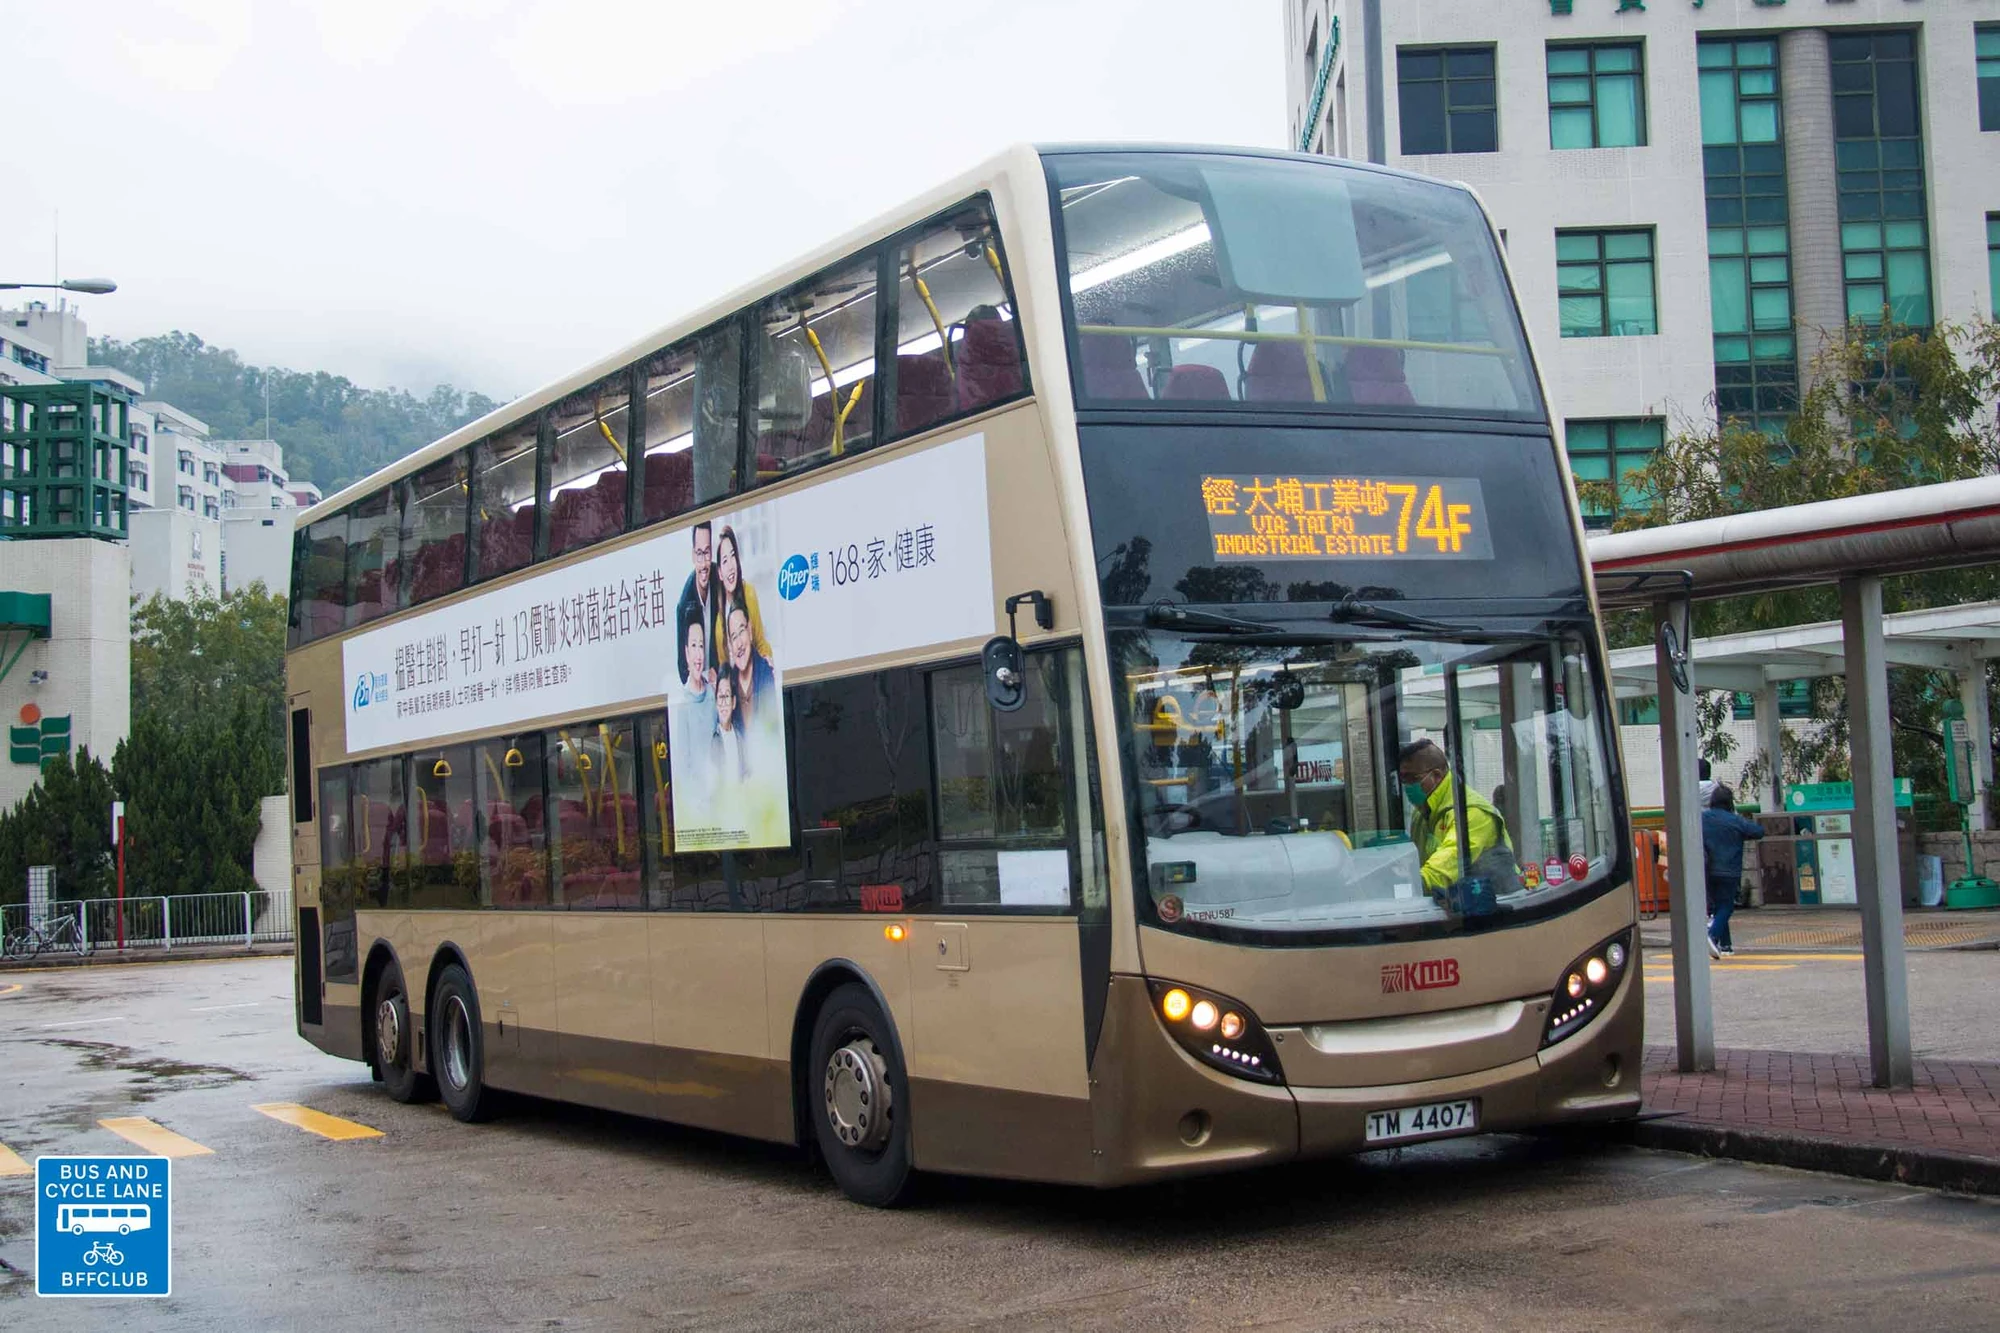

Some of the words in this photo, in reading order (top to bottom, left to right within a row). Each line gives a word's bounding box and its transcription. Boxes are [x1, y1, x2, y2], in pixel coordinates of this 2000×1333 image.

[1252, 515, 1289, 534] VIA:
[1294, 515, 1328, 534] TAI
[1332, 515, 1354, 534] PO
[1387, 484, 1471, 552] 74F
[1215, 535, 1322, 554] INDUSTRIAL
[1326, 535, 1394, 555] ESTATE
[780, 562, 809, 600] Pfizer
[1404, 958, 1460, 991] KMB
[1371, 1114, 1400, 1136] TM
[1412, 1102, 1468, 1130] 4407
